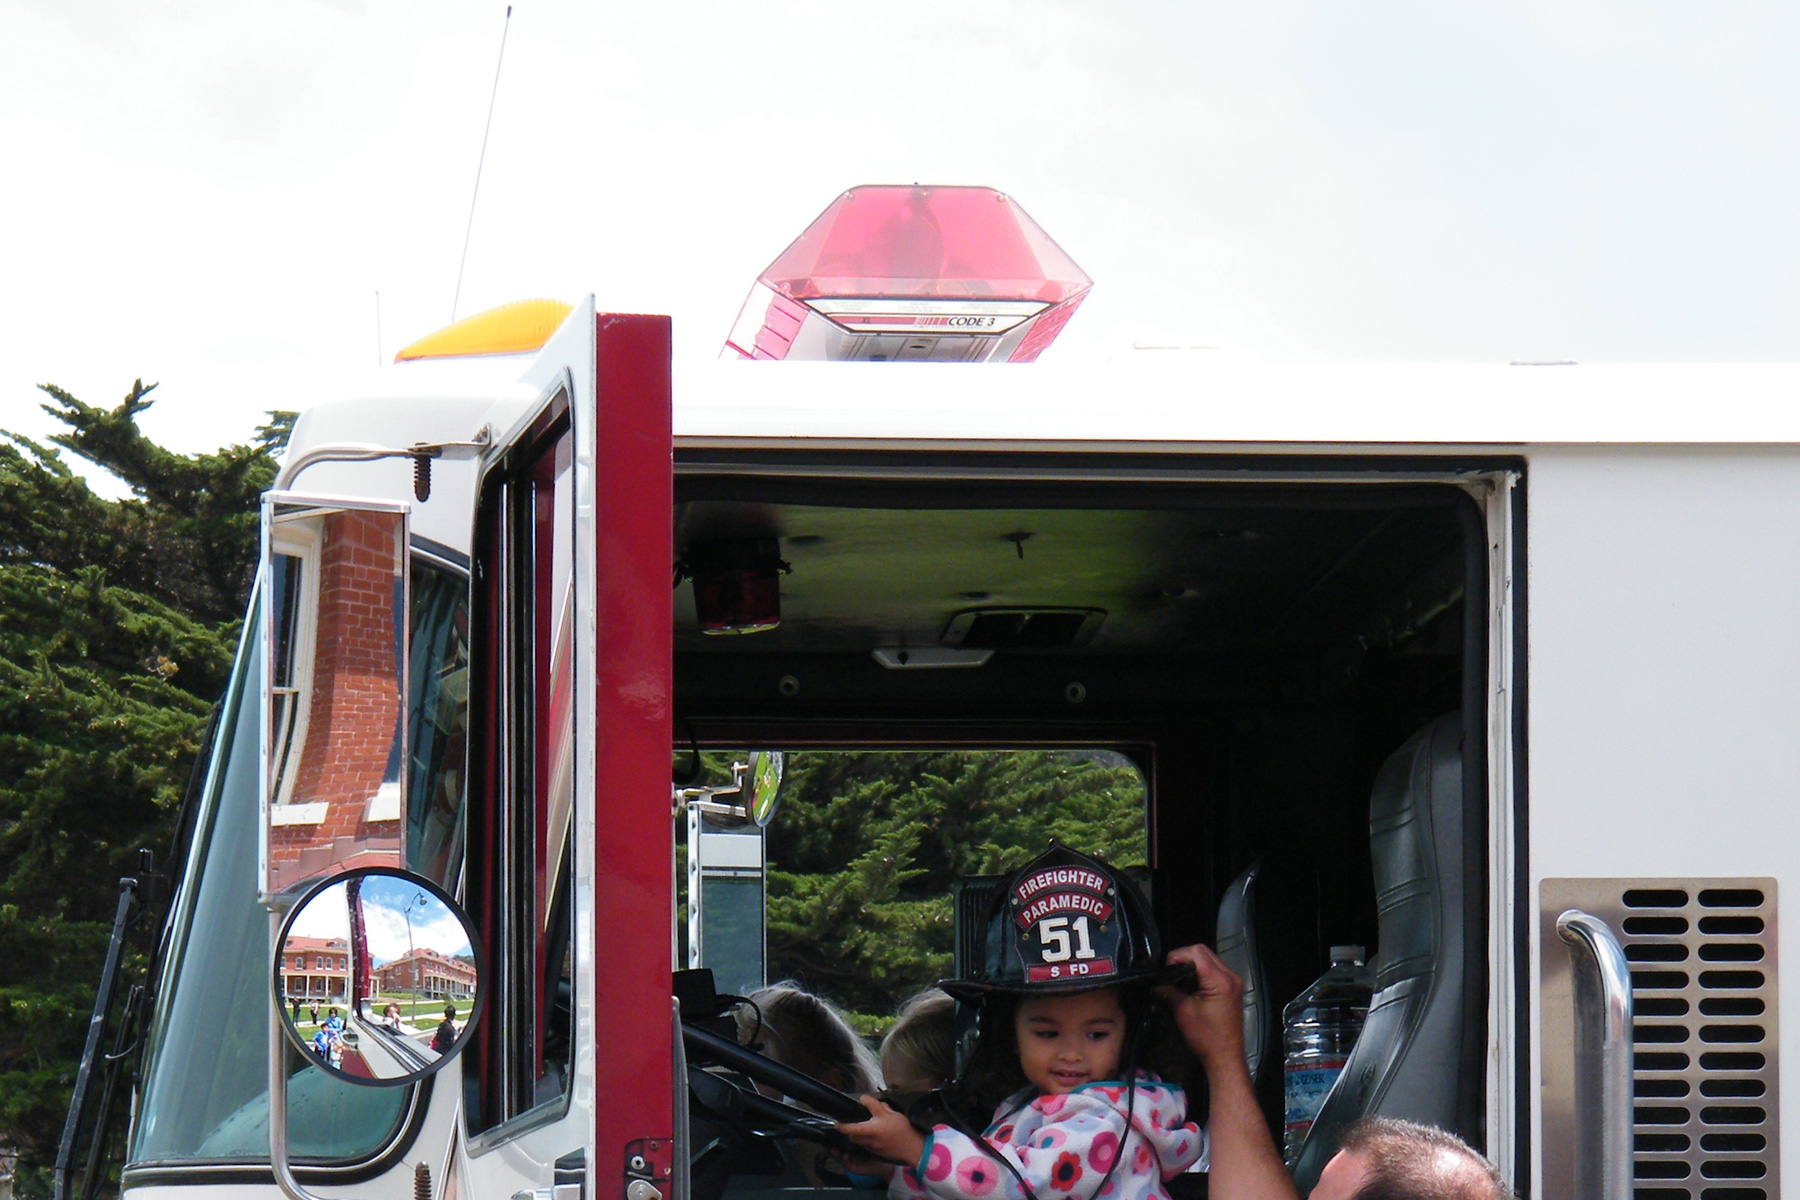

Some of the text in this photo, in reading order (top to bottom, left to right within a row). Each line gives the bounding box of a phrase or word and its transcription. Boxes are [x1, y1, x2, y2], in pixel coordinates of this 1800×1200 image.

[948, 316, 985, 327] CODE
[986, 316, 996, 327] 3
[1018, 869, 1104, 899] FIREFIGHTER
[1022, 894, 1104, 923] PARAMEDIC
[1039, 915, 1096, 963] 51
[1050, 963, 1089, 978] S FD
